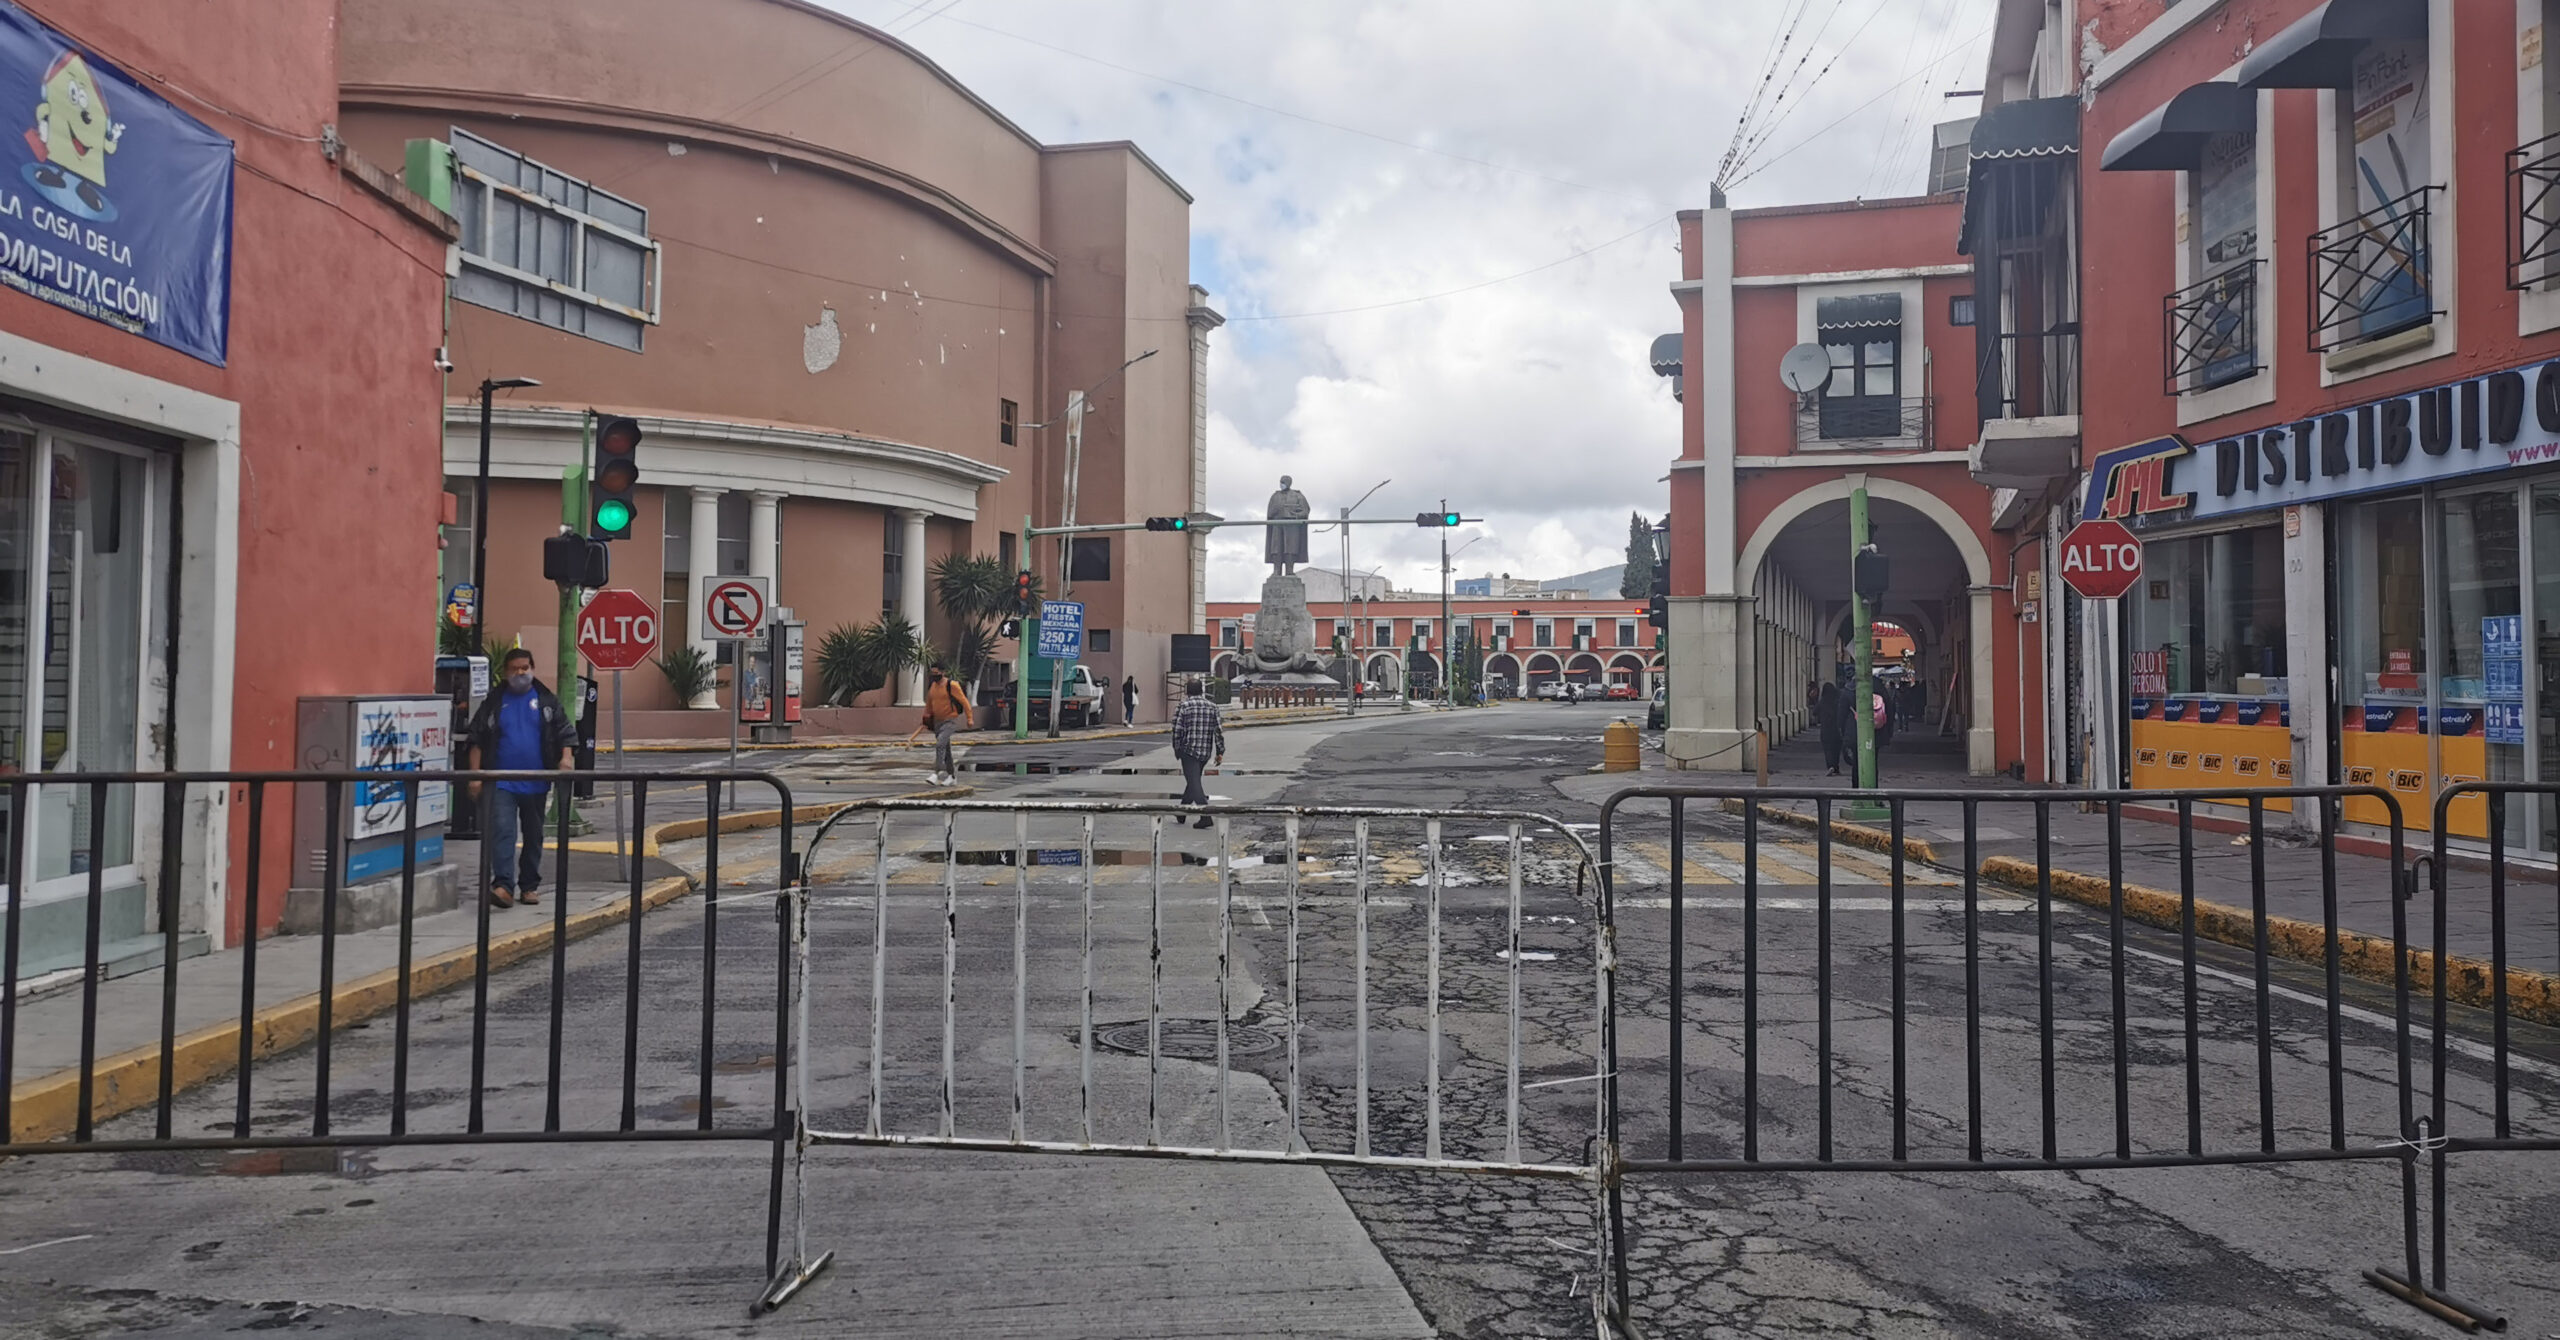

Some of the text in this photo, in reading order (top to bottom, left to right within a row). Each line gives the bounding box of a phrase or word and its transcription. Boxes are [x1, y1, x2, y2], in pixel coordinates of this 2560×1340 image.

[0, 190, 132, 268] LA CASA DE LA
[2063, 543, 2140, 573] ALTO
[1043, 604, 1081, 615] HOTEL
[1047, 613, 1075, 622] FIESTA
[579, 615, 655, 645] ALTO
[1042, 620, 1080, 629] MEXICANA
[2132, 652, 2163, 673] SOLO 1
[2132, 674, 2167, 694] PERSONA
[2365, 712, 2388, 721] estrella
[2441, 715, 2466, 725] estrella
[422, 727, 446, 750] NETFLIX
